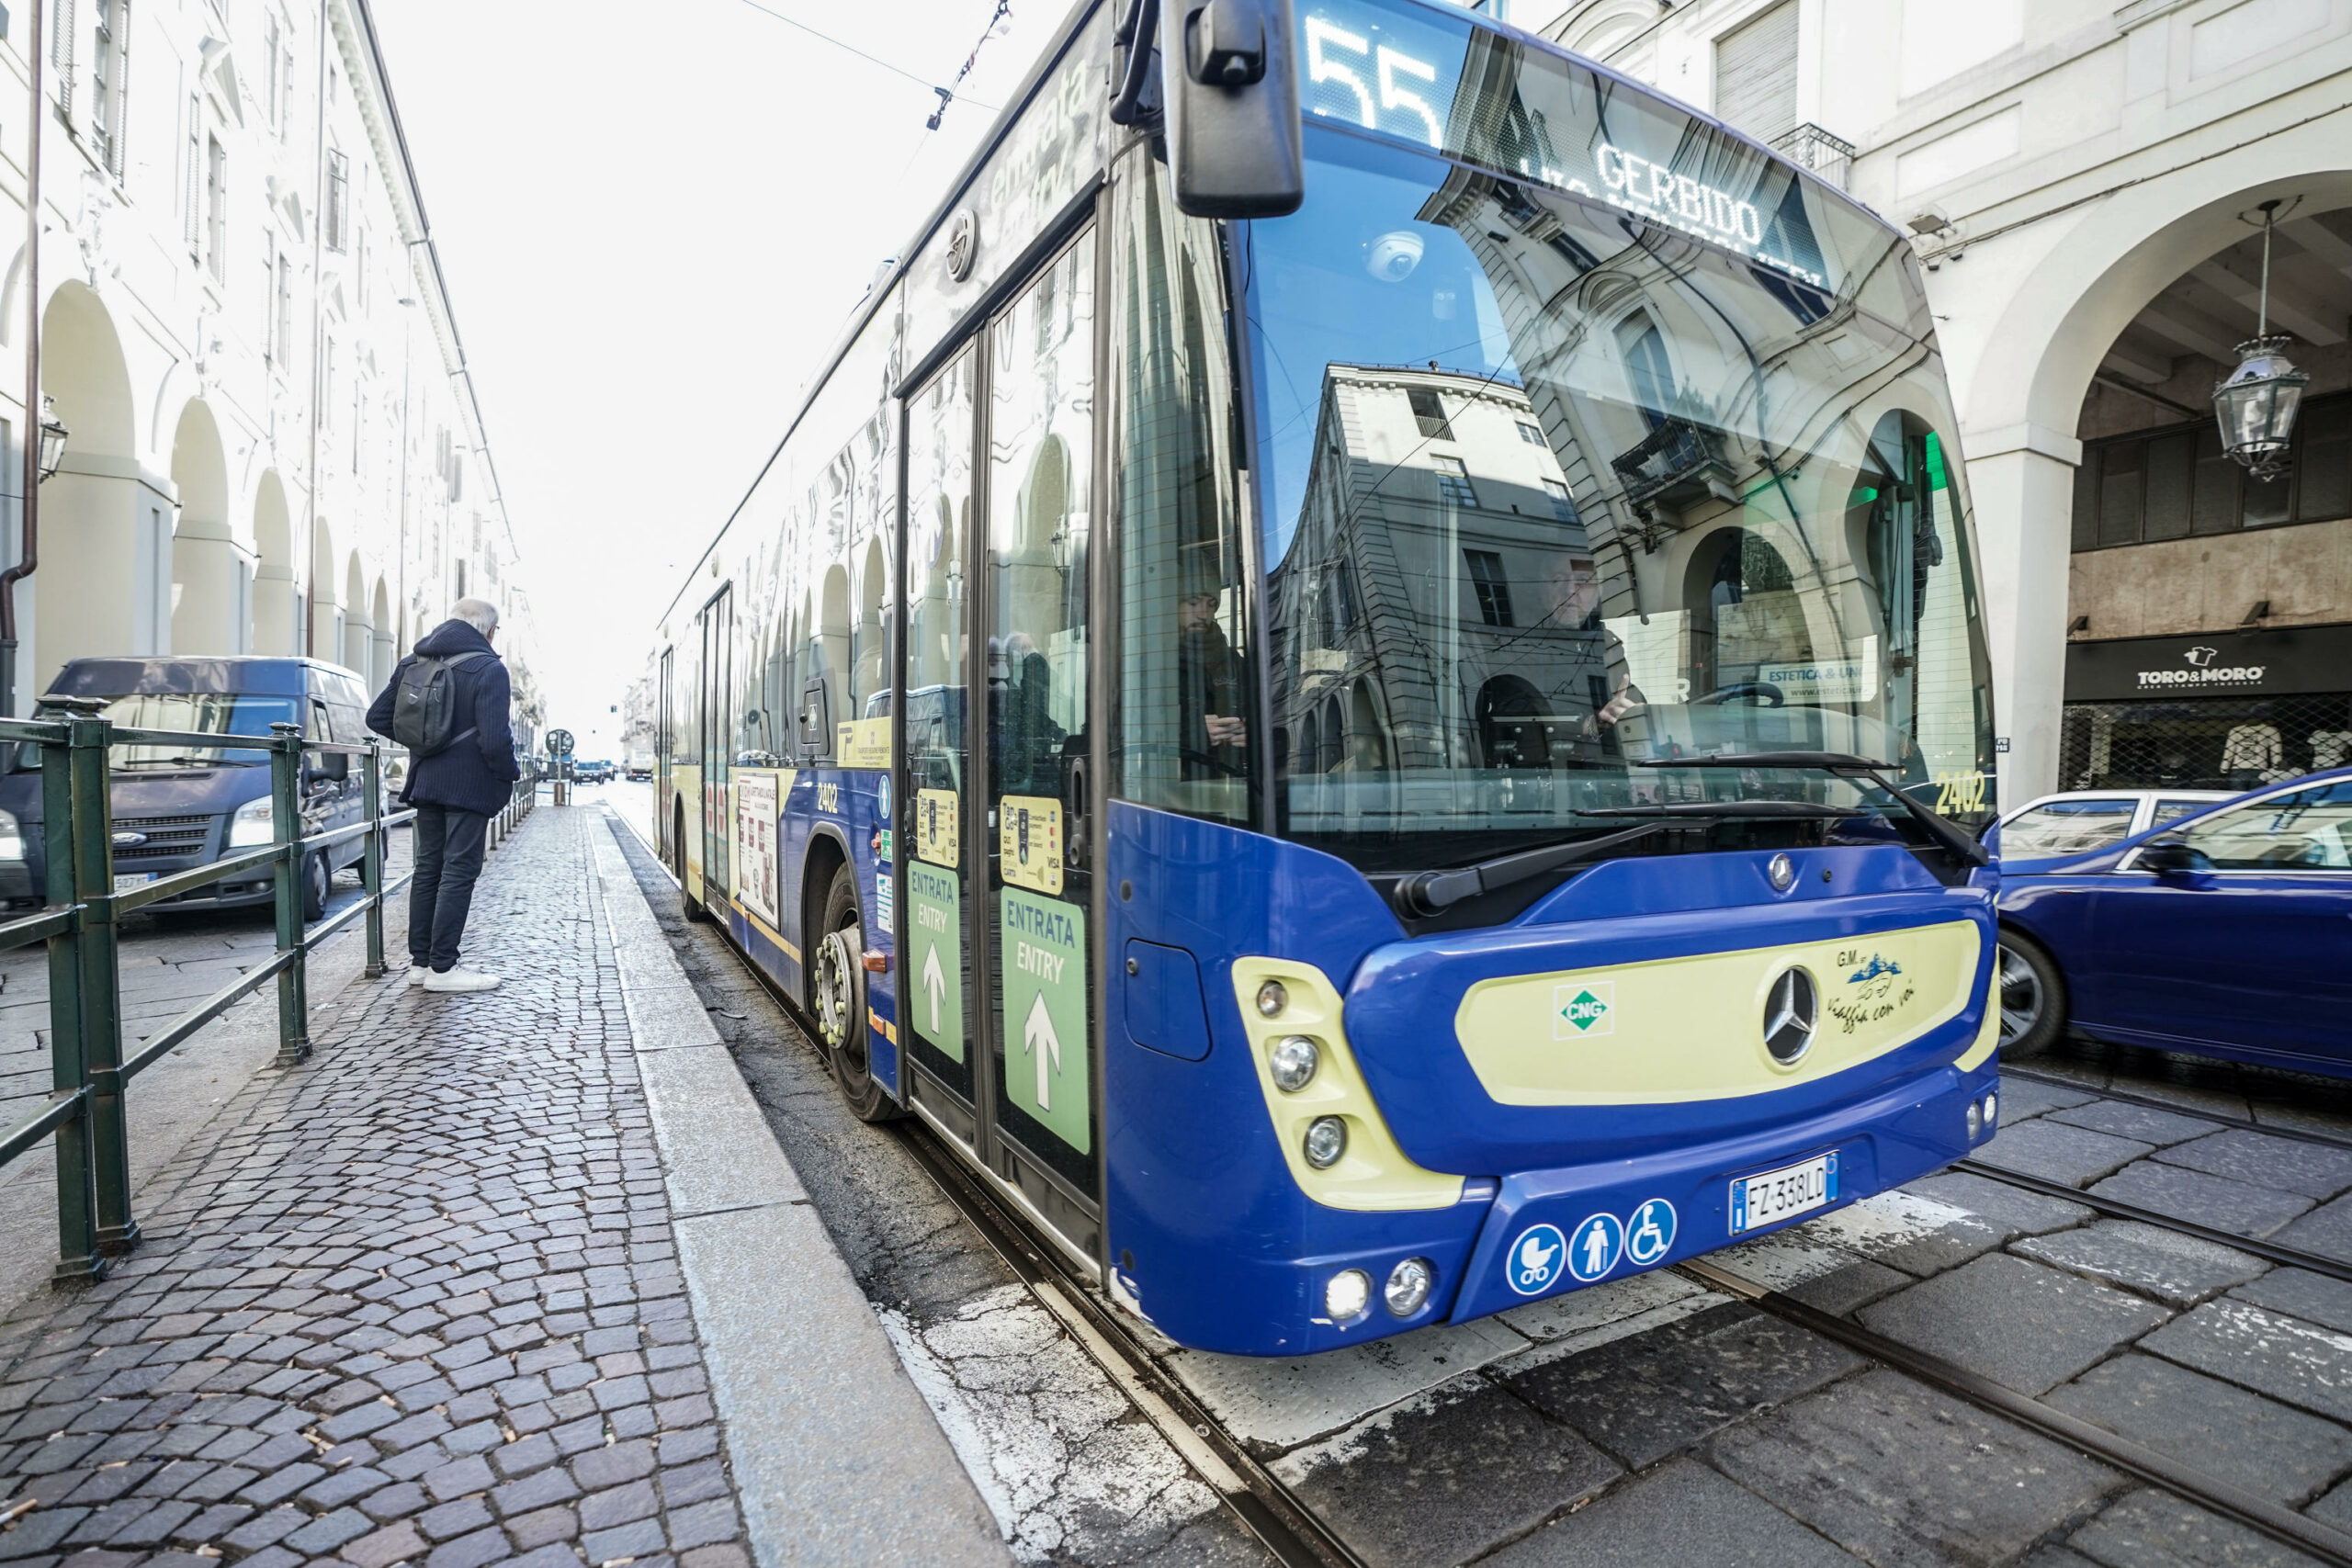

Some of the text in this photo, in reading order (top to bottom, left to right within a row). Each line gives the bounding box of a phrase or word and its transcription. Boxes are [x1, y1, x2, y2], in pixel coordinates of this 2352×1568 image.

[1306, 16, 1442, 149] 55
[1597, 142, 1762, 246] GERBIDO
[1770, 669, 1821, 682] ESTETICA
[817, 782, 838, 814] 2402
[1935, 770, 1985, 815] 2402
[1046, 856, 1059, 869] VISA
[912, 871, 954, 905] ENTRATA
[919, 904, 947, 934] ENTRY
[1007, 899, 1075, 949] ENTRATA
[1017, 941, 1065, 985] ENTRY
[1566, 1000, 1603, 1020] CNG
